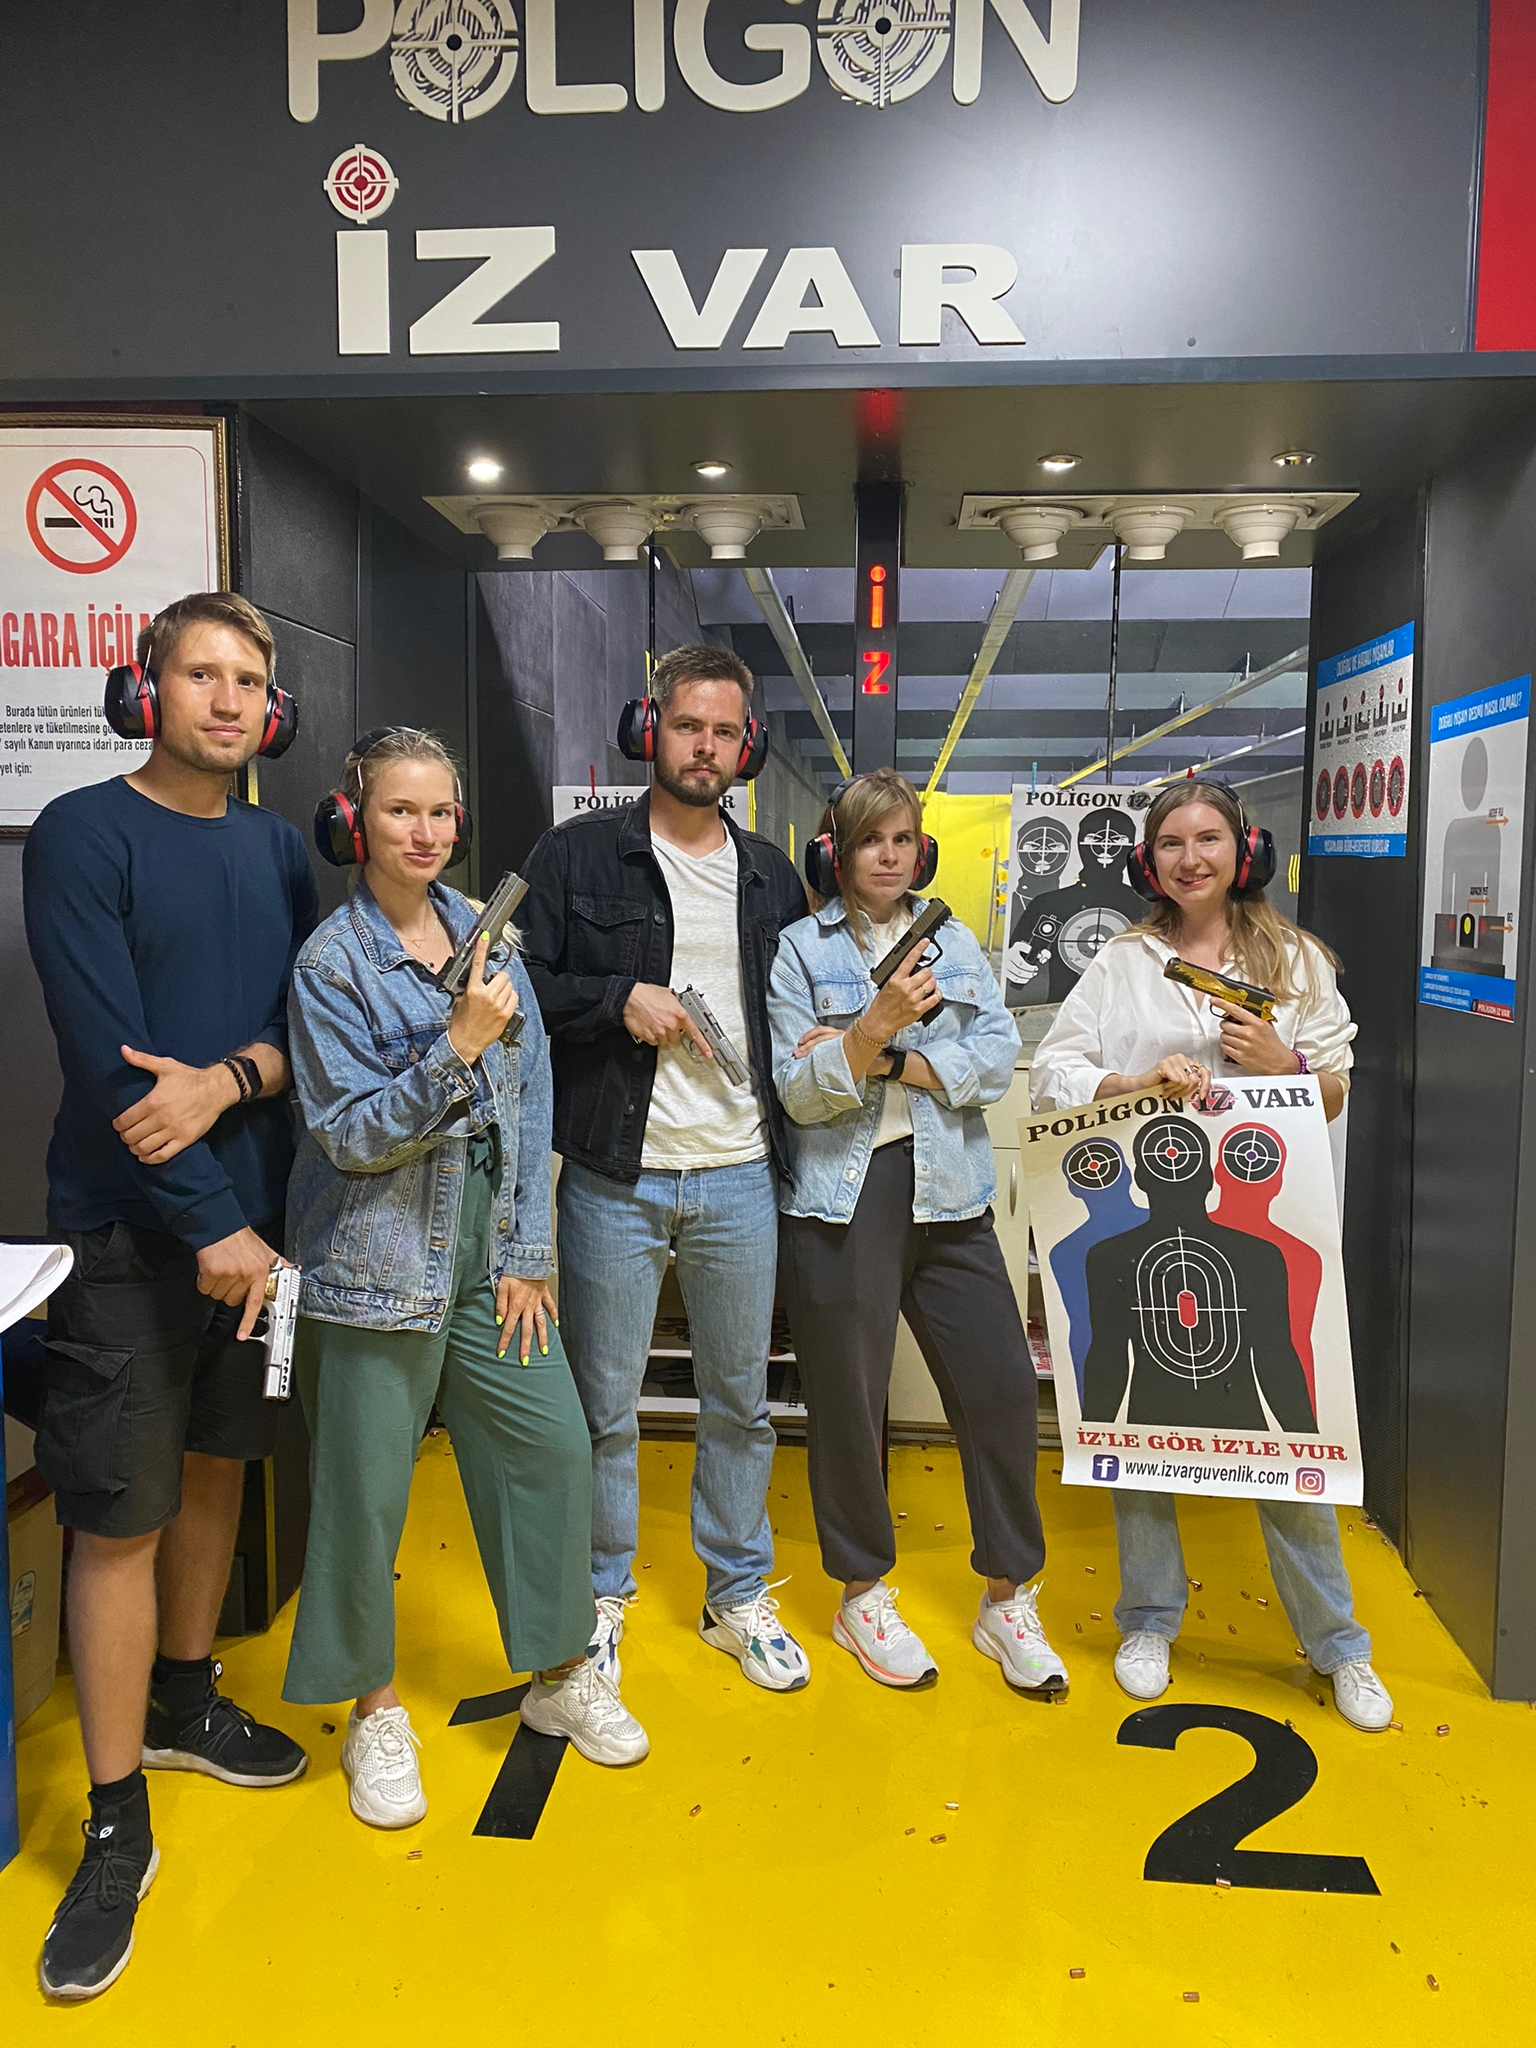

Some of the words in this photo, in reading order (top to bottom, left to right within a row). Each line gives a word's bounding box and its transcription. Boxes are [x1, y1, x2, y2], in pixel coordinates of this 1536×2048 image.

[630, 243, 1026, 350] VAR
[0, 612, 81, 668] GARA
[6, 705, 35, 717] Burada
[37, 705, 58, 717] tütün
[60, 705, 92, 717] ürünleri
[1438, 711, 1453, 731] DOĞRU
[1453, 707, 1468, 726] NİŞAN
[34, 724, 44, 733] ve
[46, 721, 100, 733] tüketilmesine
[4, 738, 26, 752] sayılı
[28, 738, 54, 749] Kanun
[56, 740, 91, 752] uyarınca
[93, 738, 112, 750] idari
[114, 740, 133, 752] para
[14, 762, 32, 777] için:
[573, 791, 641, 809] POLİG
[1026, 787, 1122, 808] POLİGON
[1477, 1002, 1496, 1014] POLİGON
[1501, 1008, 1511, 1018] VAR
[1026, 1096, 1185, 1143] POLİGON
[1241, 1087, 1315, 1109] VAR
[1076, 1427, 1140, 1448] İZ'LE
[1147, 1432, 1205, 1453] GÖR
[1212, 1434, 1281, 1456] İZ'LE
[1287, 1443, 1348, 1461] VUR
[1125, 1460, 1289, 1486] www.izvarguvenlik.com
[1116, 1703, 1382, 1896] 2
